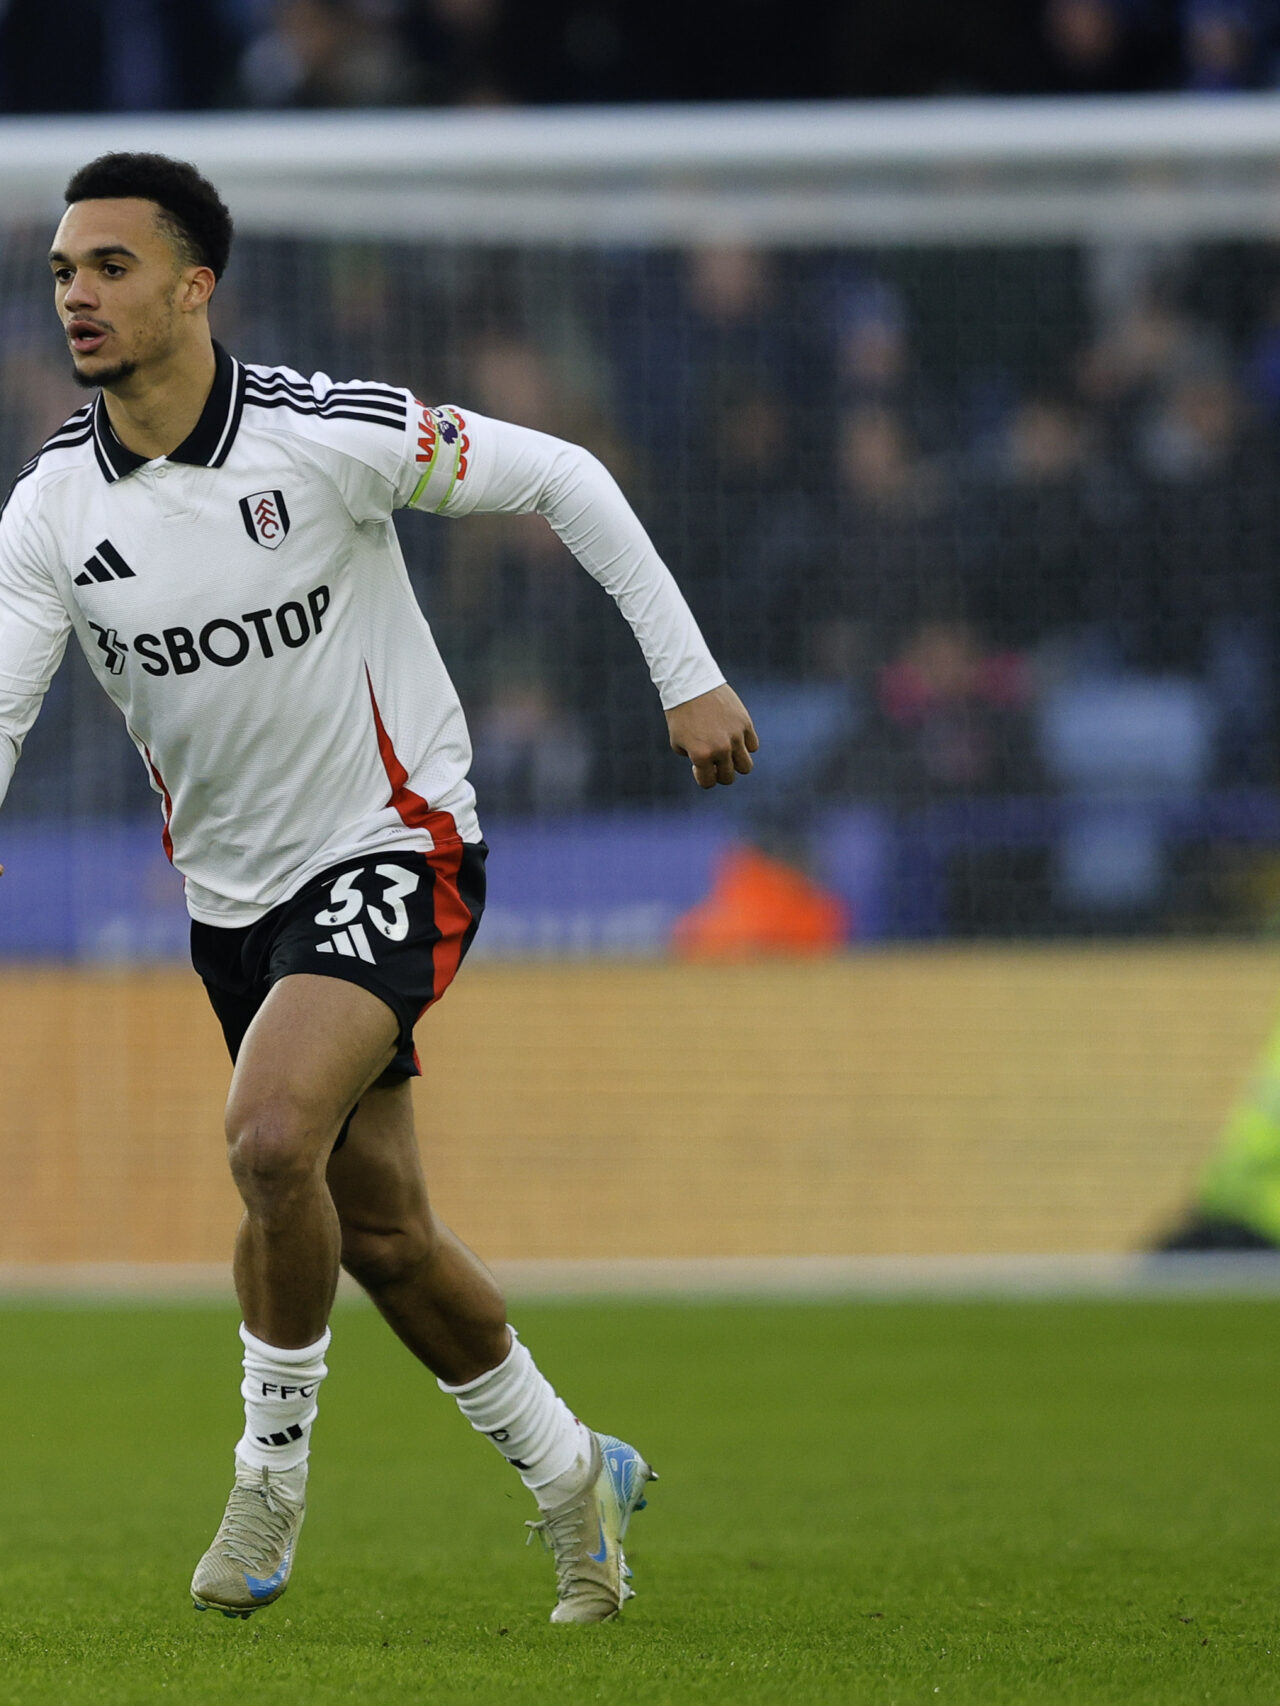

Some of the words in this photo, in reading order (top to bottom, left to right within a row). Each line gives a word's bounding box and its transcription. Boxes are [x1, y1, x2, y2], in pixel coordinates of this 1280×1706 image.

[254, 498, 280, 540] FFC
[133, 585, 330, 677] SBOTOP
[314, 863, 419, 941] 33
[262, 1382, 314, 1399] FFC
